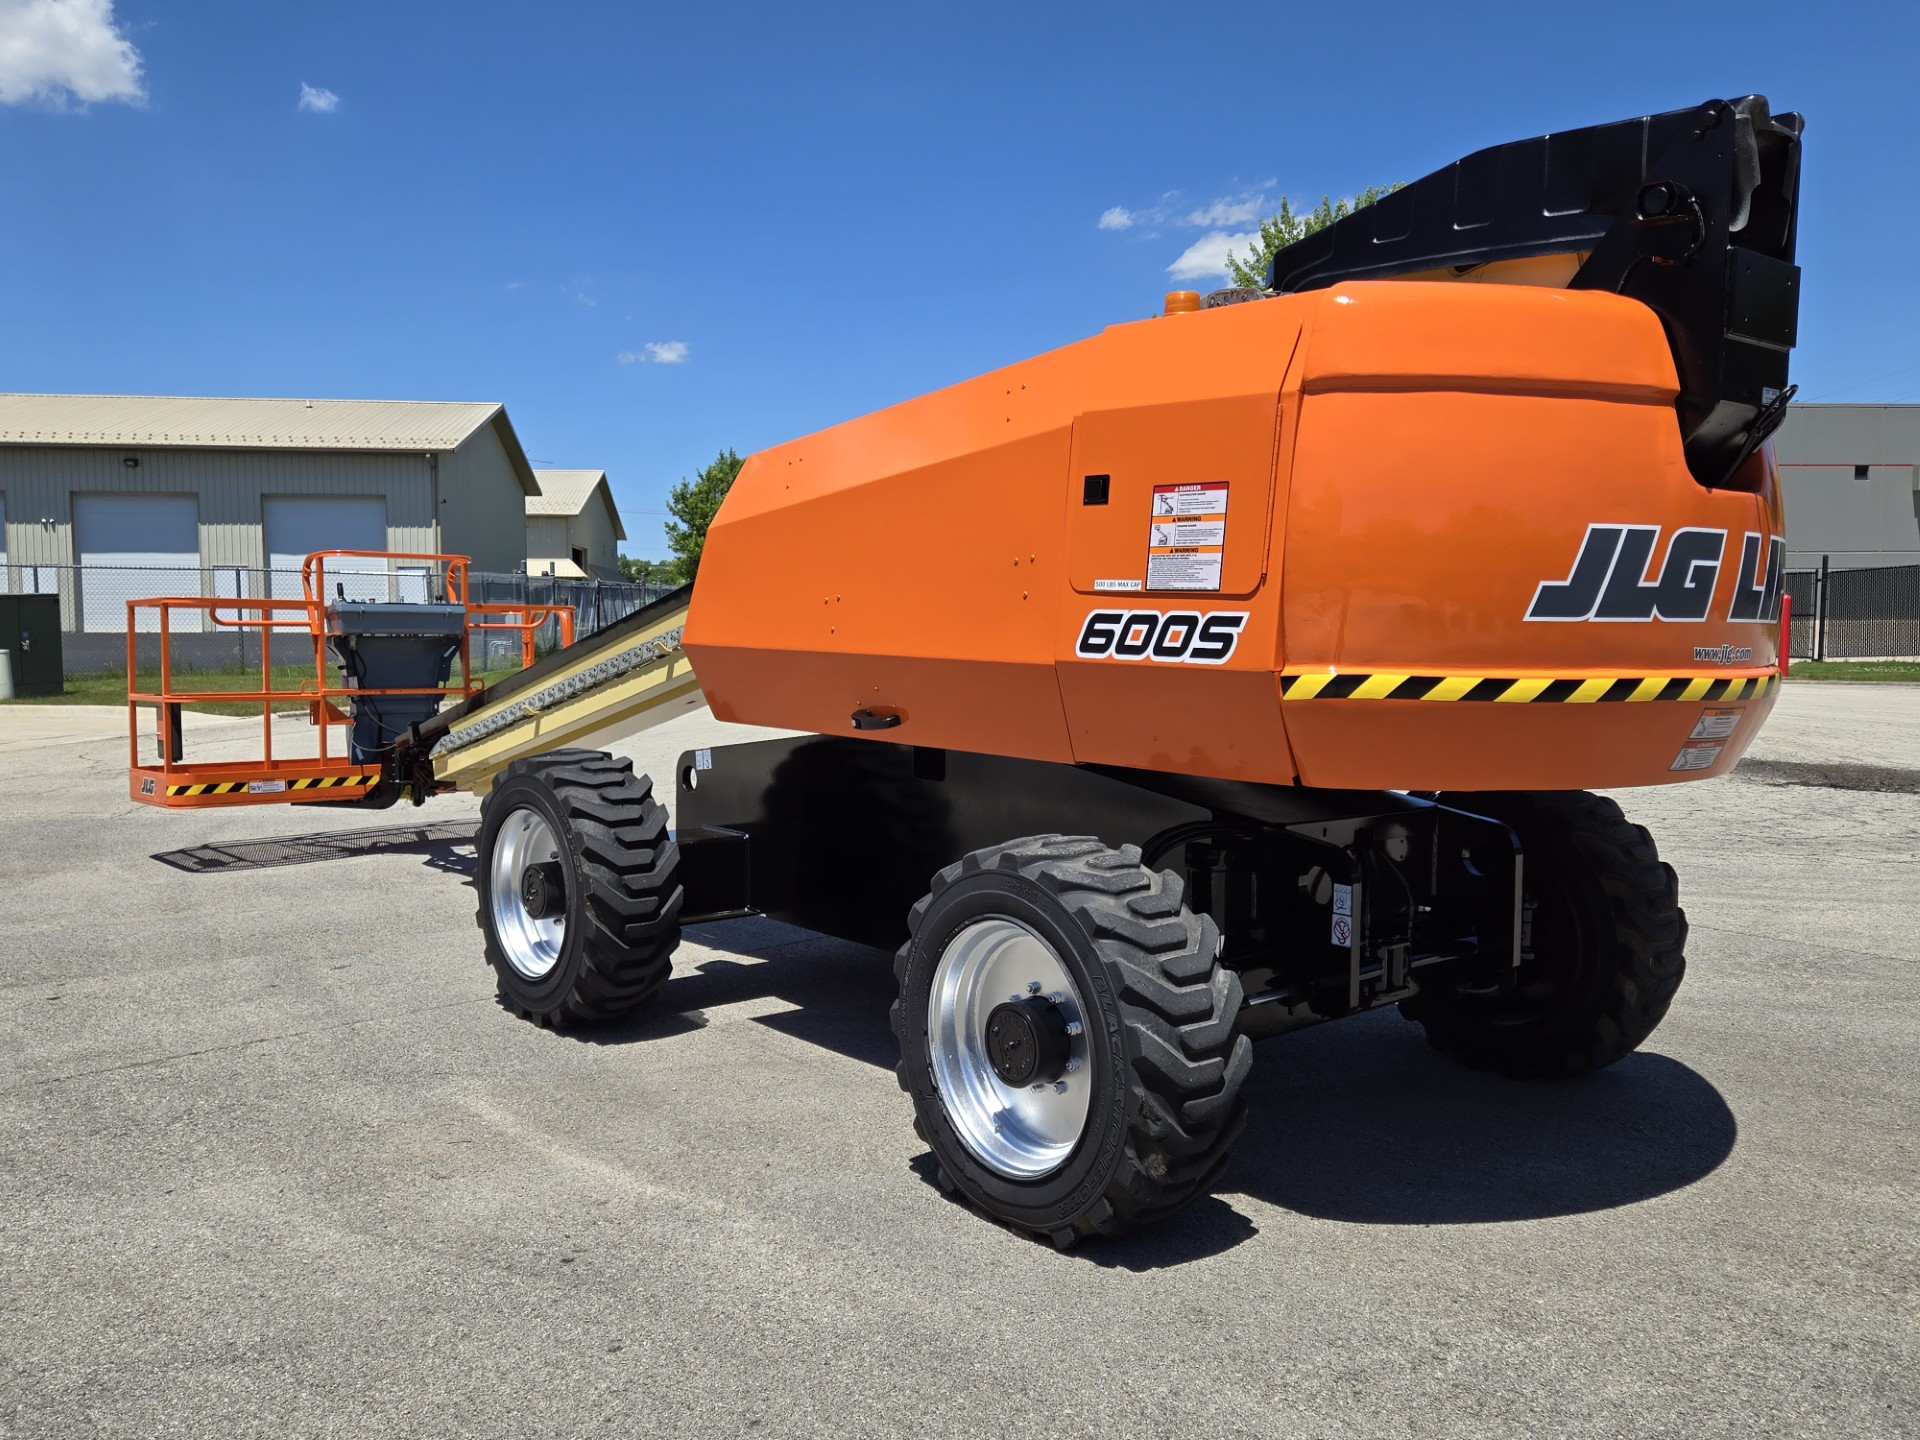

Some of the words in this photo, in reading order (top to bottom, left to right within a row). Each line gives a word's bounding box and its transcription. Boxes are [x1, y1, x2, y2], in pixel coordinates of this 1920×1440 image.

[1522, 523, 1728, 622] JLG
[1076, 609, 1250, 664] 600S
[1694, 645, 1751, 664] www.jlg.com
[141, 777, 155, 796] JLG
